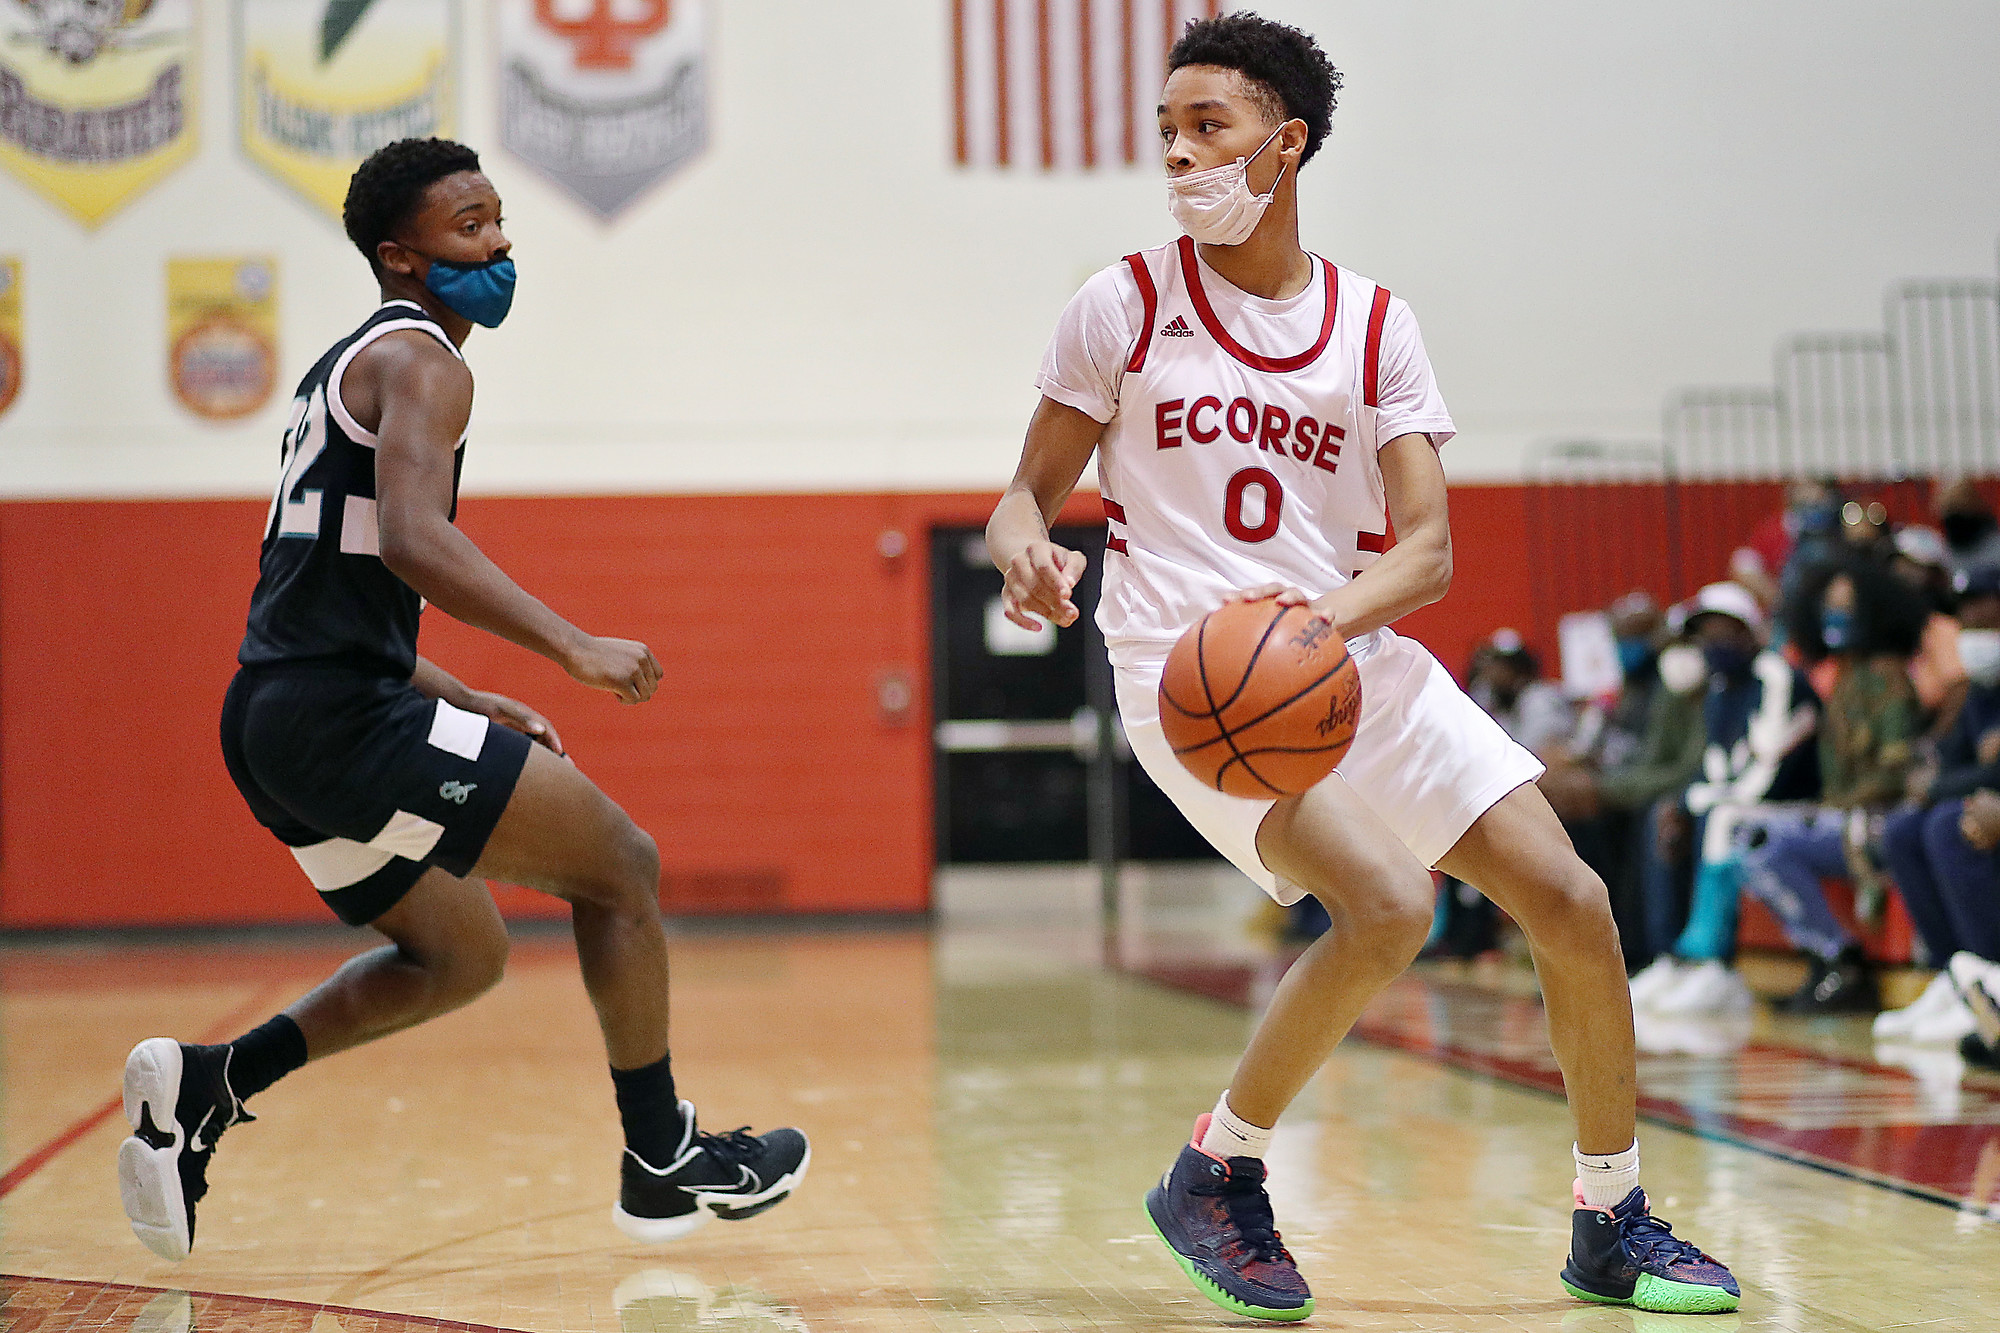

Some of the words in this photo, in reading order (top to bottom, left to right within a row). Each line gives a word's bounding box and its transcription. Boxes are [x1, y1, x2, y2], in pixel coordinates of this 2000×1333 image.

[1160, 328, 1195, 337] adidas
[1155, 394, 1347, 475] ECORSE
[1223, 465, 1284, 545] 0
